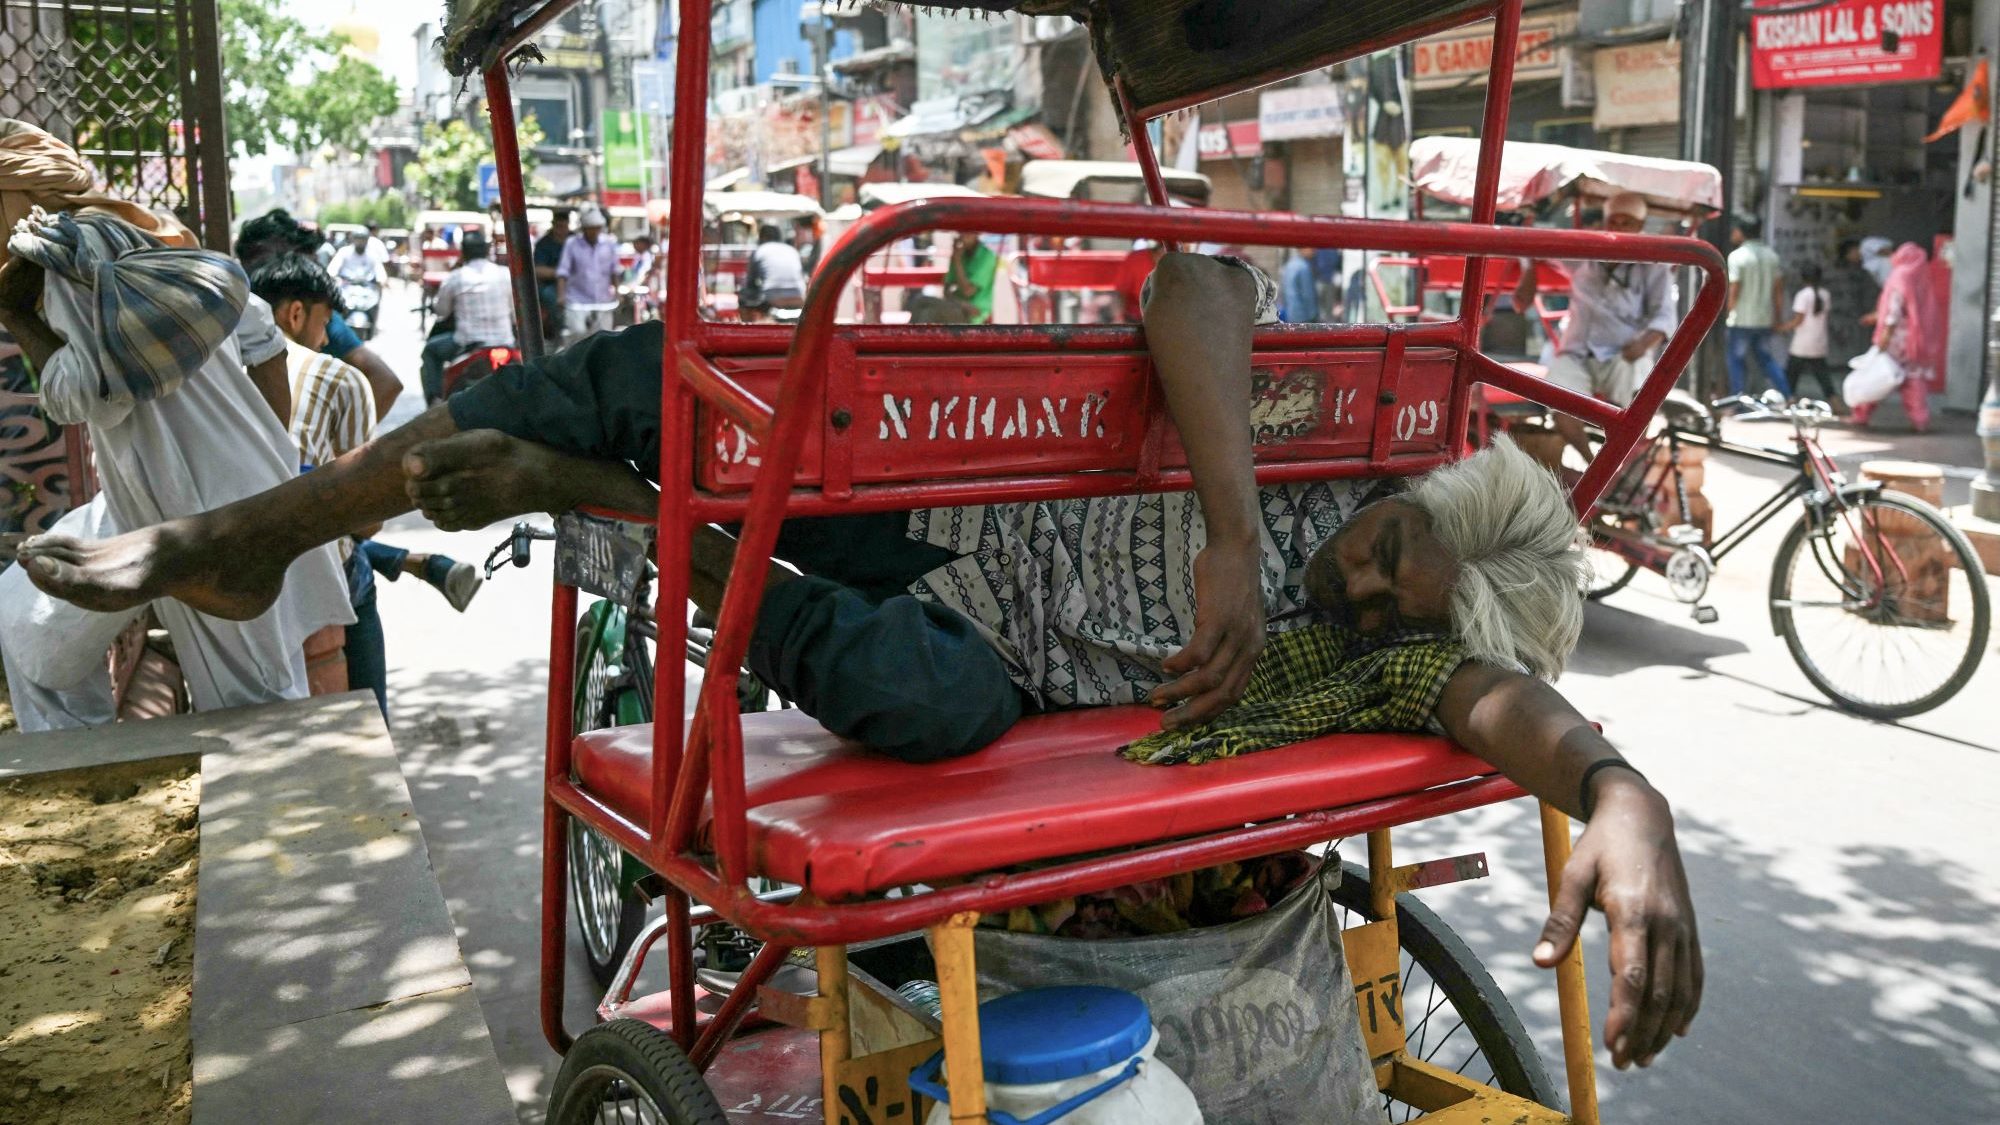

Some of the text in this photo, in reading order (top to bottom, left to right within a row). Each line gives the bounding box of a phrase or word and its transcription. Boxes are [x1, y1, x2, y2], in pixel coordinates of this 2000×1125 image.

[1756, 0, 1934, 49] KISHAN LAL & SONS
[1436, 31, 1550, 72] GARMTS
[1396, 400, 1439, 441] 09
